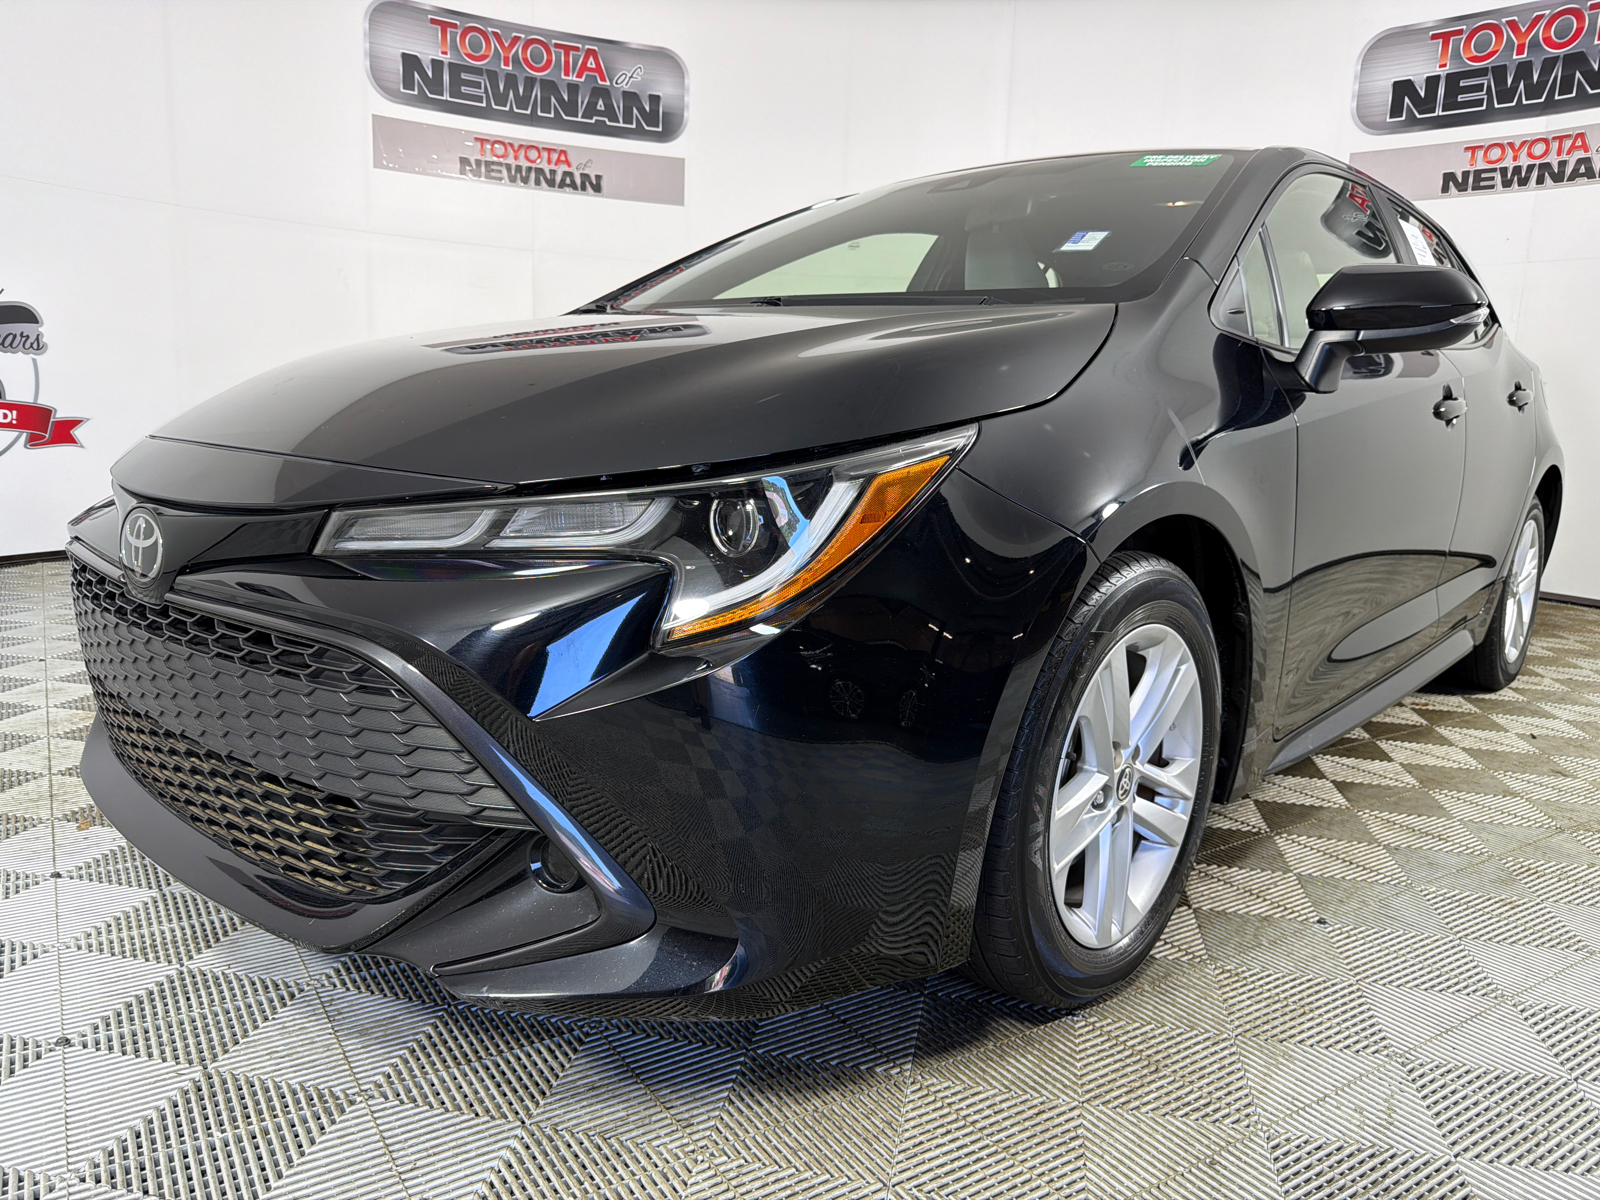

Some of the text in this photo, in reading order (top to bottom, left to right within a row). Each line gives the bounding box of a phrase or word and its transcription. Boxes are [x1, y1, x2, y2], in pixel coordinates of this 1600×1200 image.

[428, 16, 643, 88] TOYOTA of
[400, 52, 663, 131] NEWNAN
[474, 136, 592, 171] TOYOTA of
[1463, 131, 1591, 168] TOYOTA
[458, 156, 604, 194] NEWNAN
[1440, 155, 1600, 195] NEWNA
